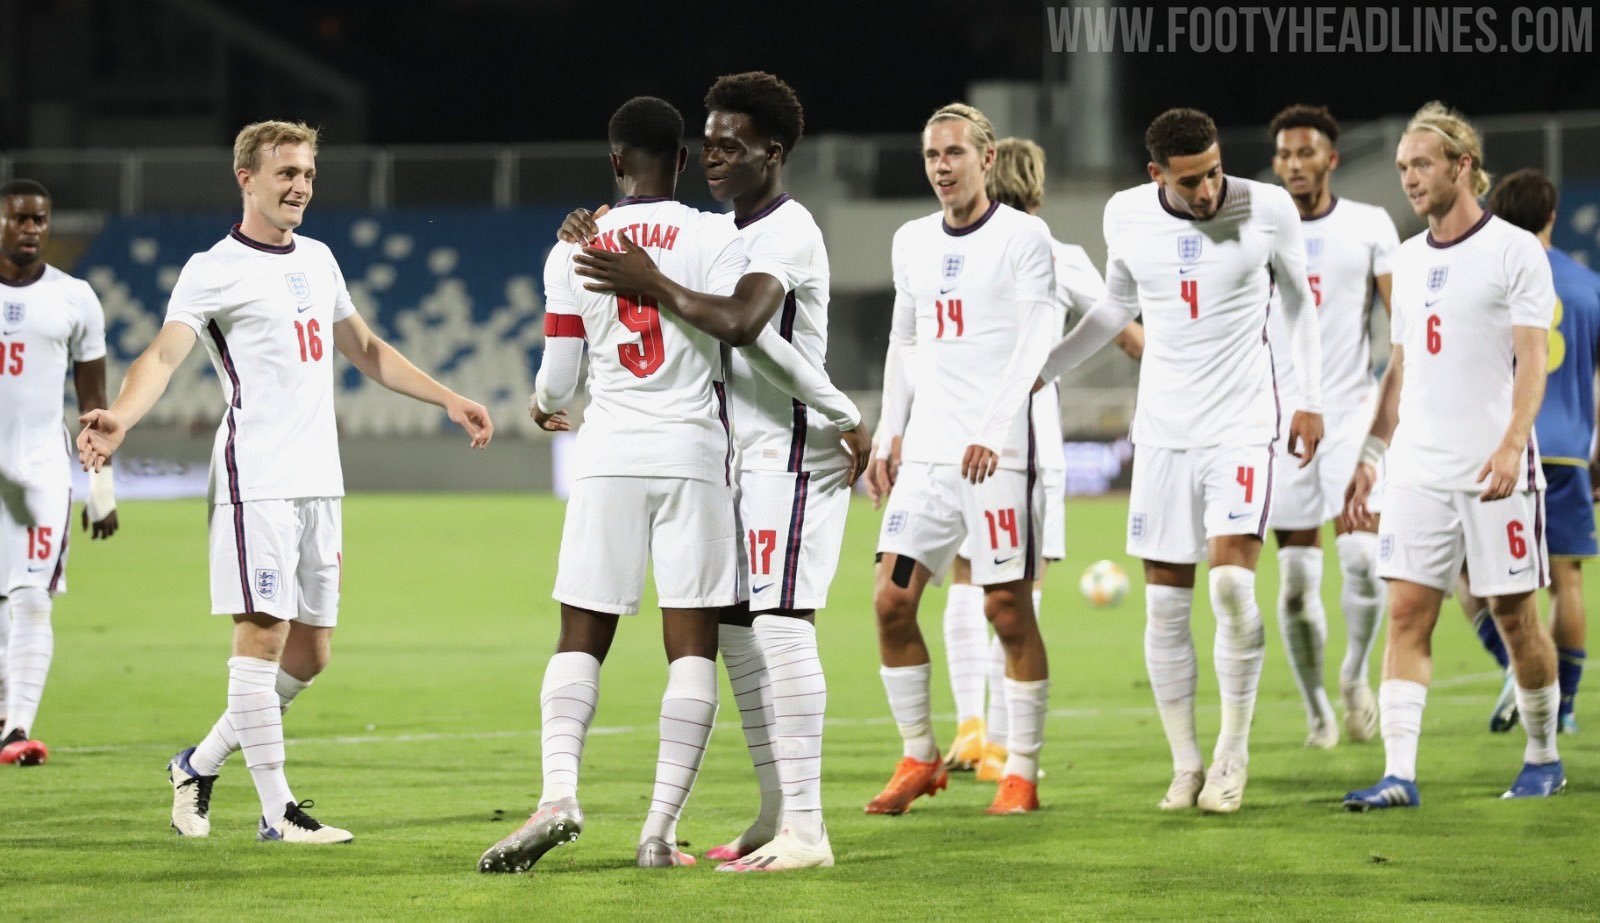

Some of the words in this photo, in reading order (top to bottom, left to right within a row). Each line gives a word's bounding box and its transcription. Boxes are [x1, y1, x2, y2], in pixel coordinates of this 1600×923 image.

[935, 299, 965, 339] 14
[1180, 280, 1199, 319] 4
[294, 319, 323, 362] 16
[615, 293, 666, 379] 9
[1426, 314, 1442, 355] 6
[1236, 466, 1255, 504] 4
[27, 526, 52, 560] 15
[984, 508, 1019, 550] 14
[1506, 520, 1527, 559] 6
[748, 529, 777, 575] 17
